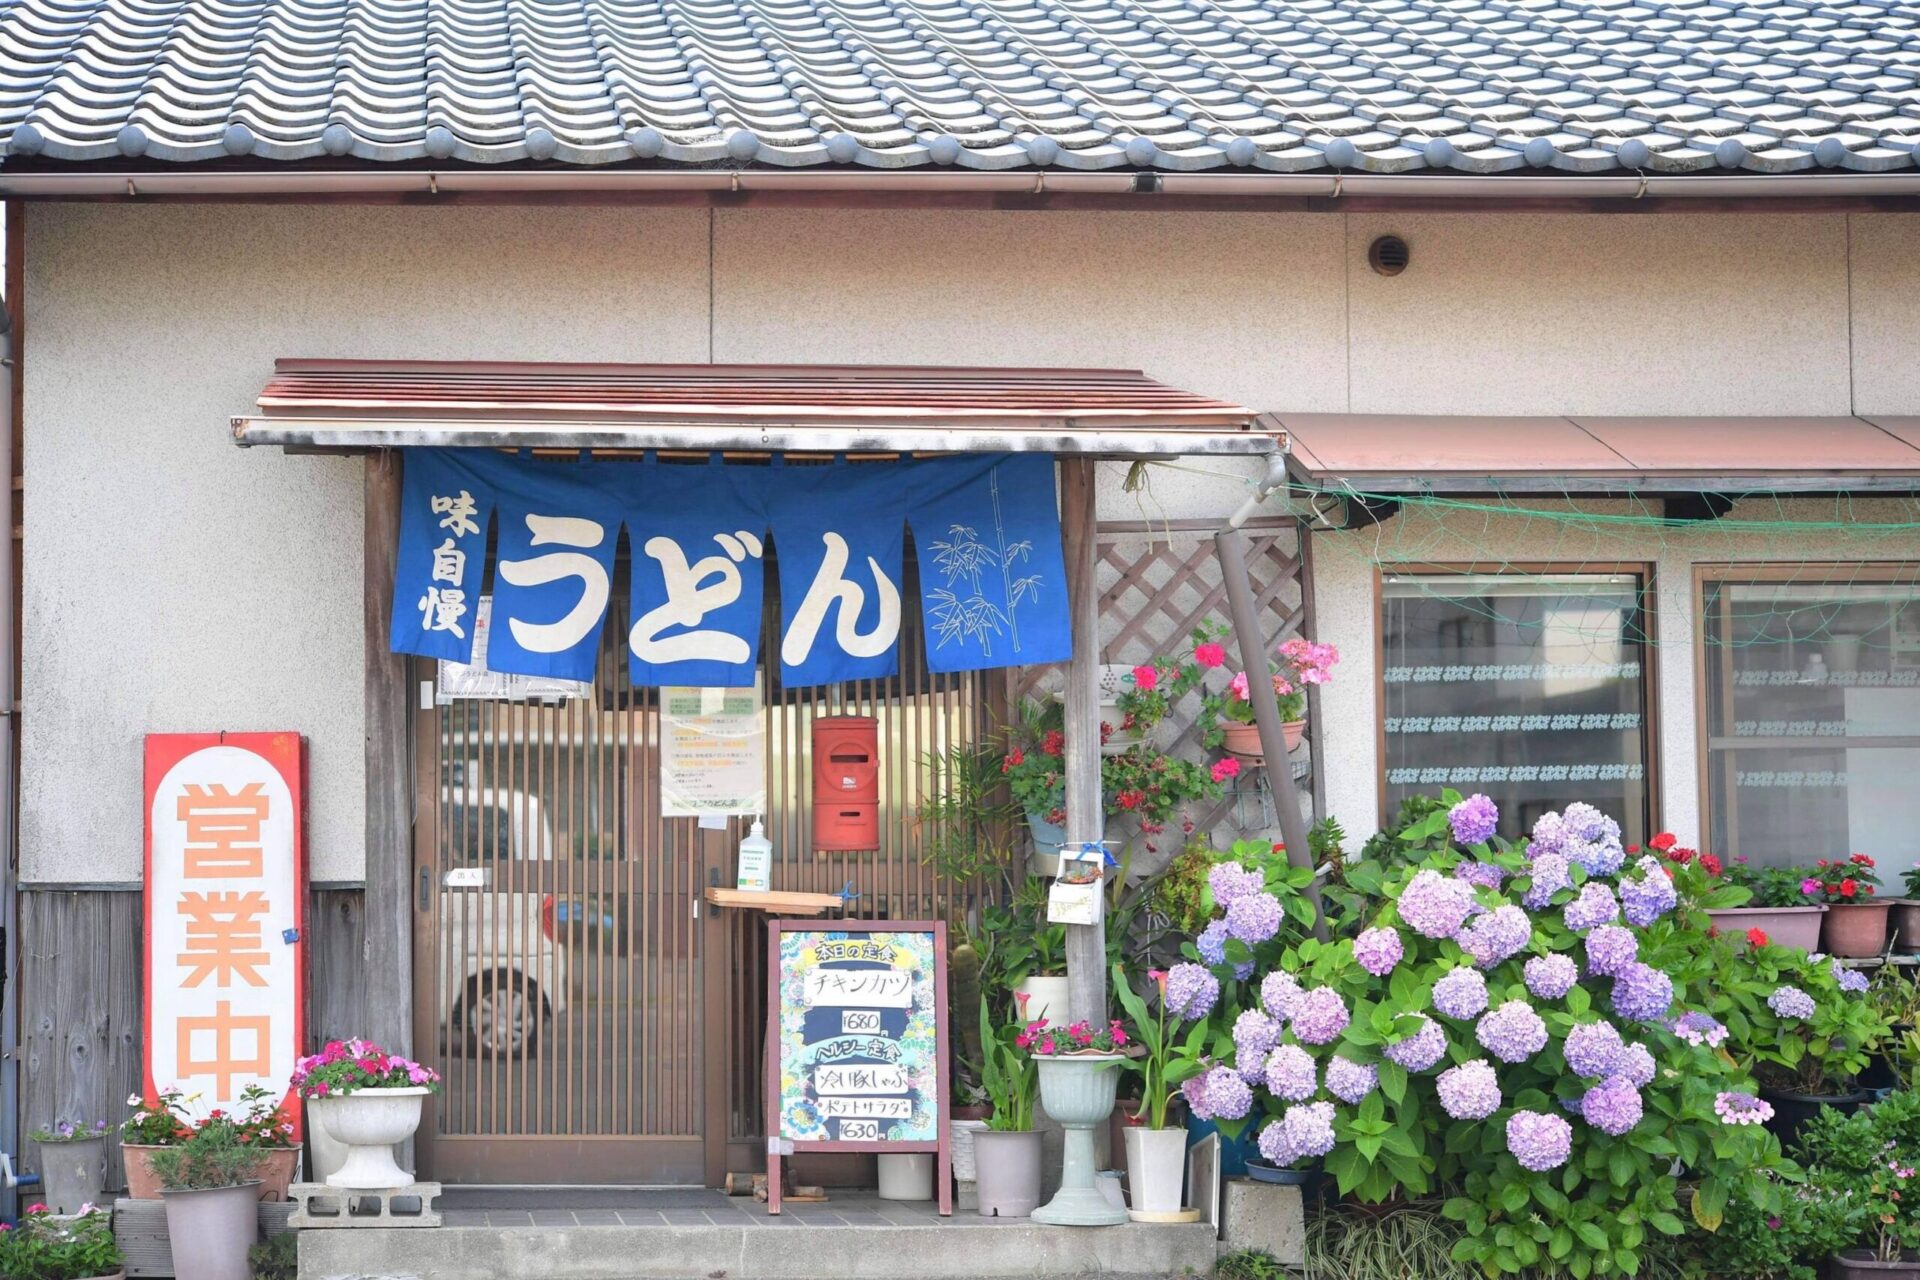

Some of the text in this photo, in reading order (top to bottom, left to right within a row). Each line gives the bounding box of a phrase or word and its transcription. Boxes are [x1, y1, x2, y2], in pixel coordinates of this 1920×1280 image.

[417, 489, 480, 640] 味自慢
[499, 513, 902, 667] うどん
[176, 782, 270, 1102] 営業中
[815, 941, 897, 963] 本日の定食
[813, 974, 910, 996] チキンカツ
[815, 1038, 902, 1063] ヘルシー定食
[824, 1099, 907, 1116] ポテトサラダ
